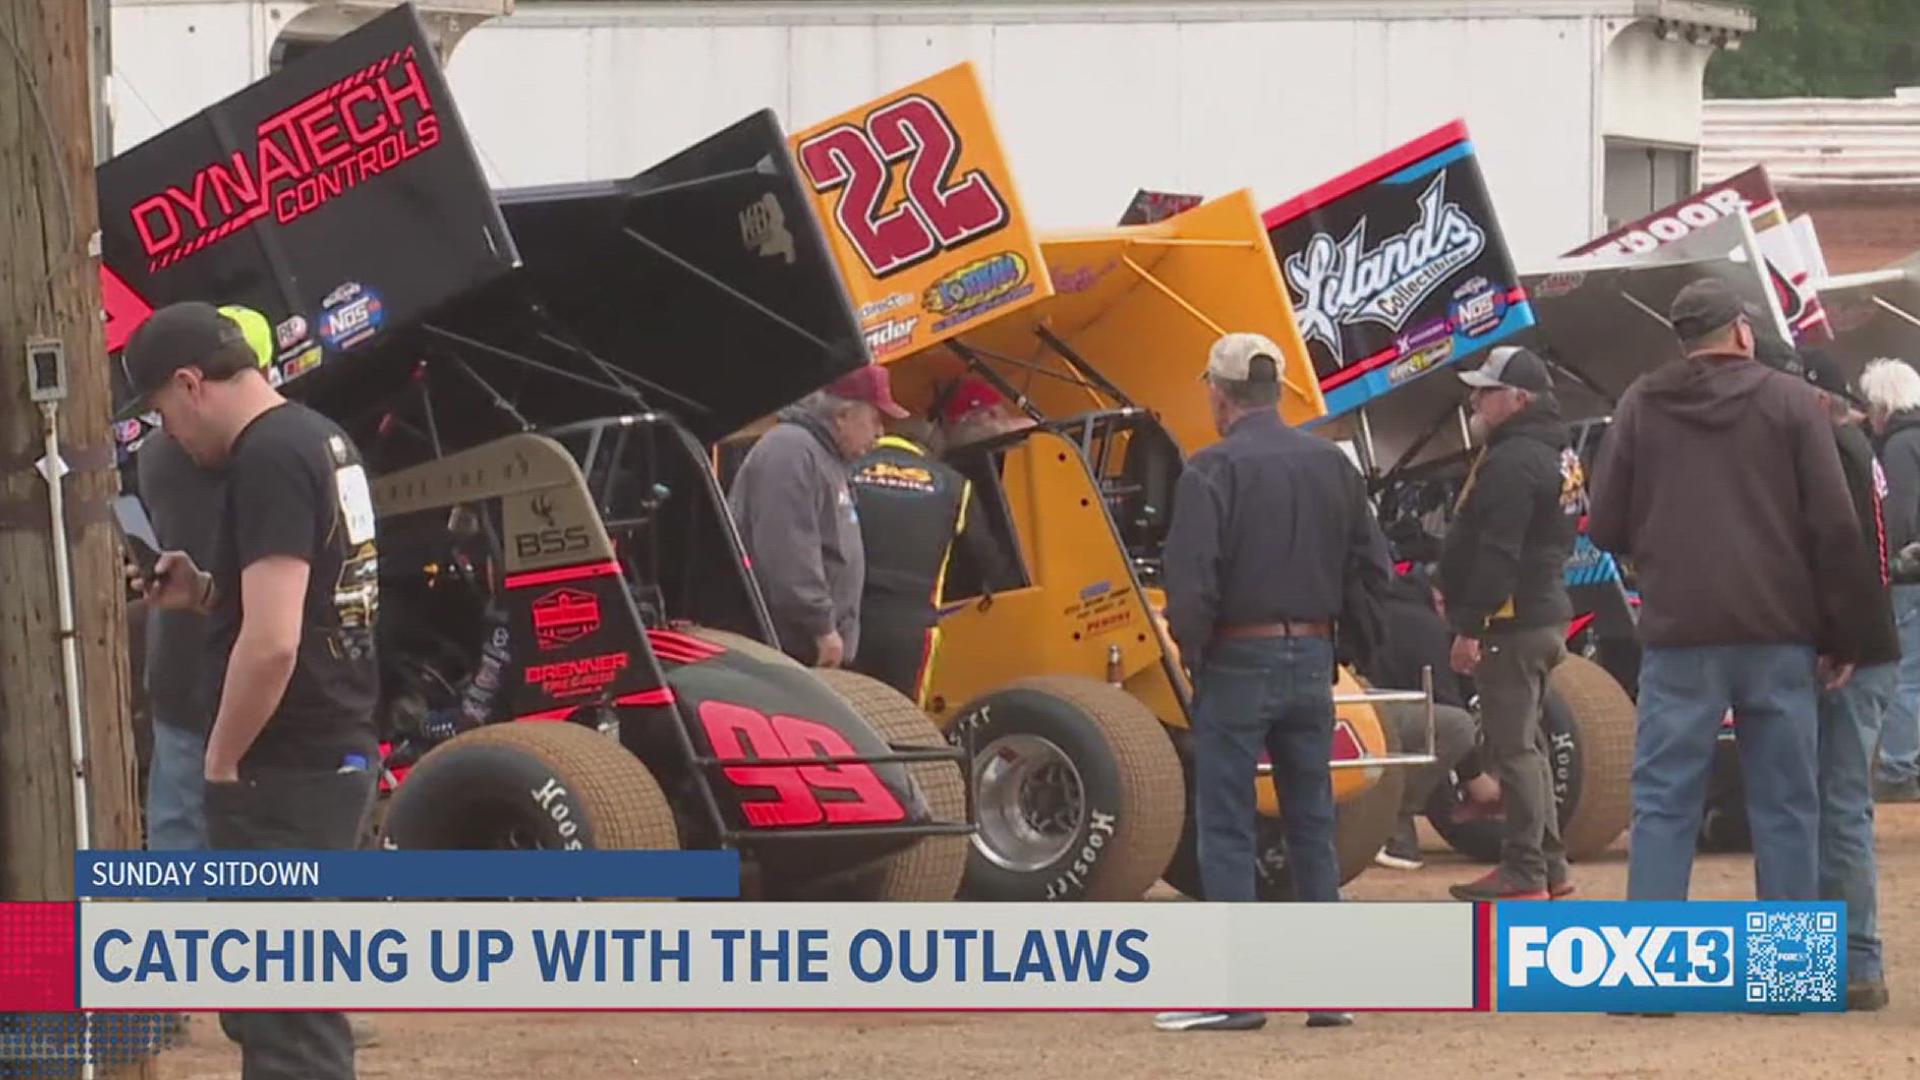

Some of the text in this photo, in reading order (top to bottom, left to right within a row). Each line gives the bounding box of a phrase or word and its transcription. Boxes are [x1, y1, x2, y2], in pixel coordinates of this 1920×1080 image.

[130, 58, 434, 257] DYNATECH
[274, 113, 442, 225] CONTROLS
[798, 93, 1010, 279] 22
[328, 297, 370, 337] NOS
[1376, 249, 1469, 317] Collectibles
[516, 526, 591, 558] BSS
[698, 699, 907, 829] 99
[1045, 807, 1116, 900] Hoosier
